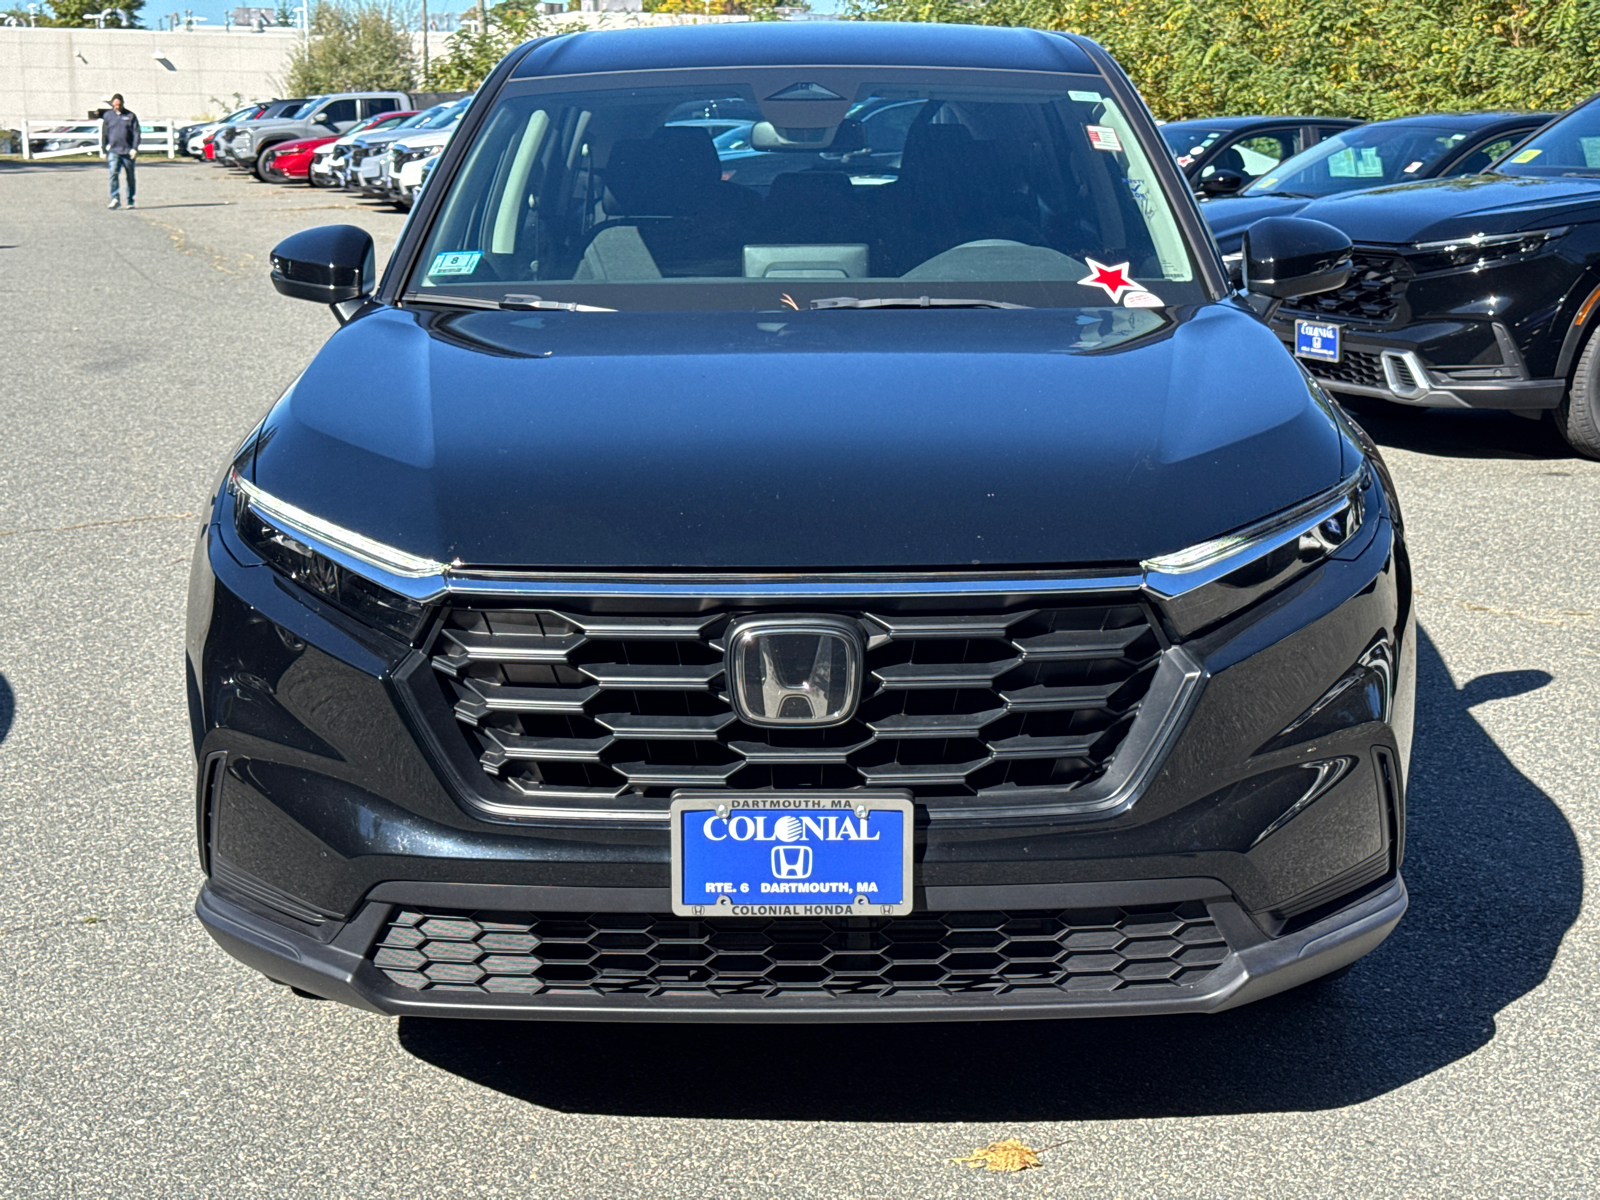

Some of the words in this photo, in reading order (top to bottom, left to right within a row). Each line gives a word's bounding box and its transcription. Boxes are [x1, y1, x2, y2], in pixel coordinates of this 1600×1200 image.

[450, 256, 460, 264] 8
[731, 800, 826, 809] DARTMOUTH,
[830, 800, 852, 808] MA
[703, 815, 881, 842] COLONIAL
[705, 882, 737, 893] RTE.
[739, 882, 750, 893] 6
[760, 882, 853, 894] DARTMOUTH,
[856, 881, 878, 892] MA
[731, 905, 800, 915] COLONIAL
[804, 905, 853, 915] HONDA
